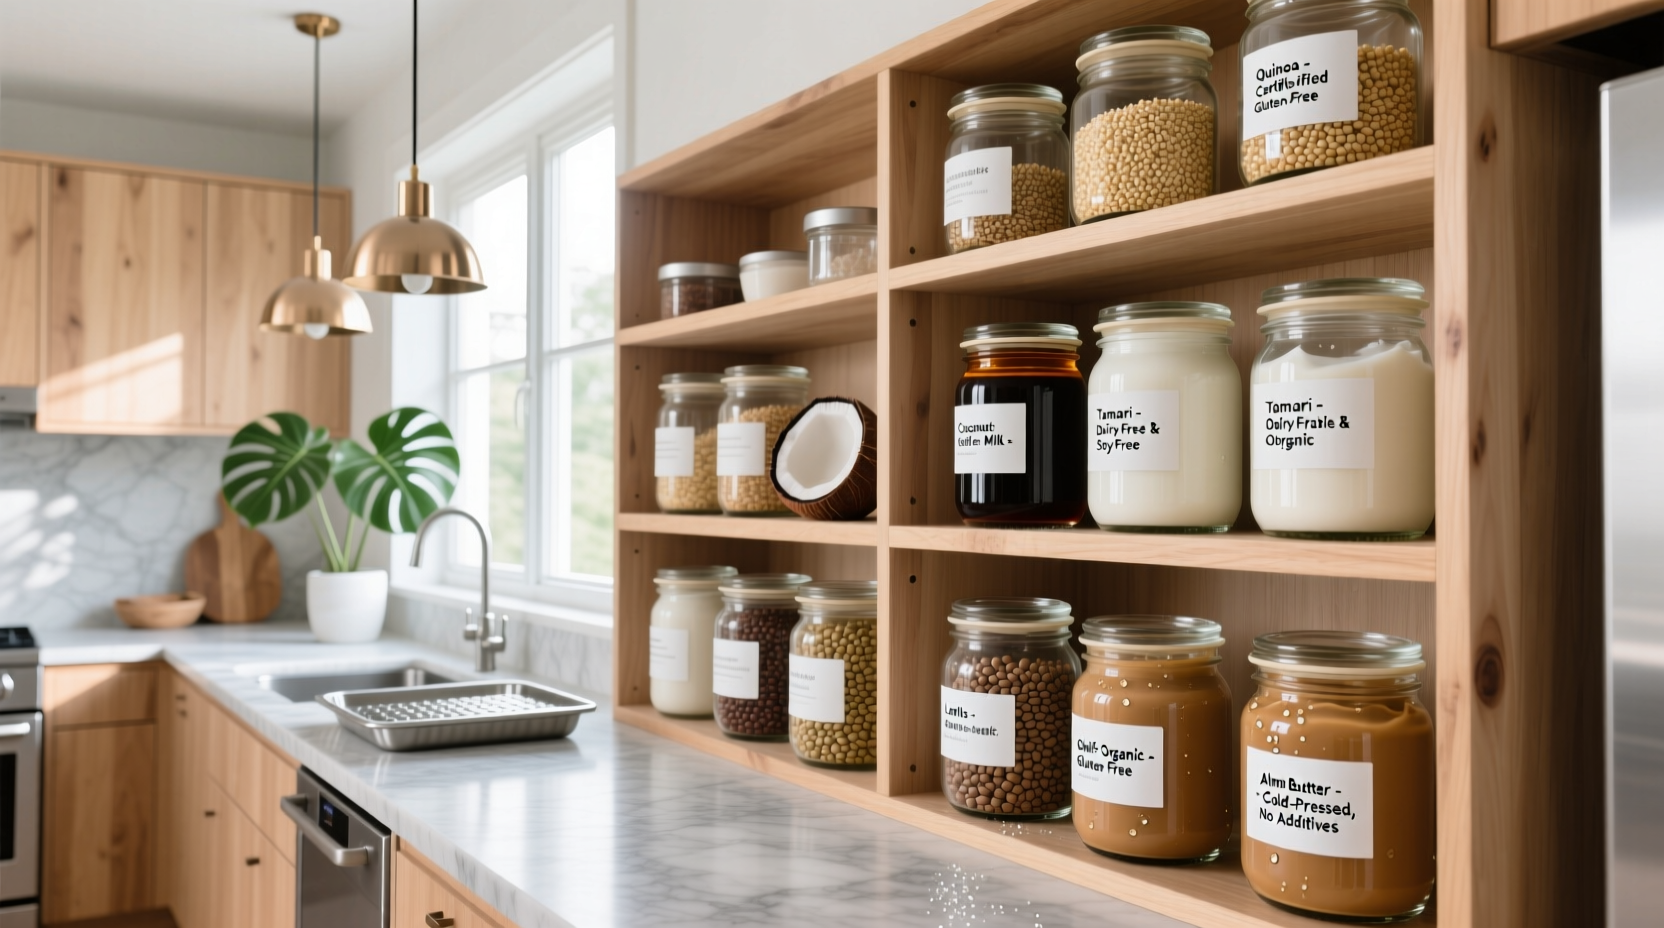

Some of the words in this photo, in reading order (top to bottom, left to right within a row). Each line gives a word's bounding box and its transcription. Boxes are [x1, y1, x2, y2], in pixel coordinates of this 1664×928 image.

[1256, 62, 1300, 81] Quinoa
[1290, 91, 1319, 104] Free
[1096, 406, 1133, 420] Tamari
[1121, 423, 1146, 435] Free
[1150, 421, 1161, 435] &
[1339, 415, 1350, 429] &
[1096, 439, 1114, 455] Soy
[1114, 438, 1141, 451] Free
[1107, 761, 1133, 777] Free
[1259, 807, 1274, 822] No
[1276, 812, 1340, 834] Additives
